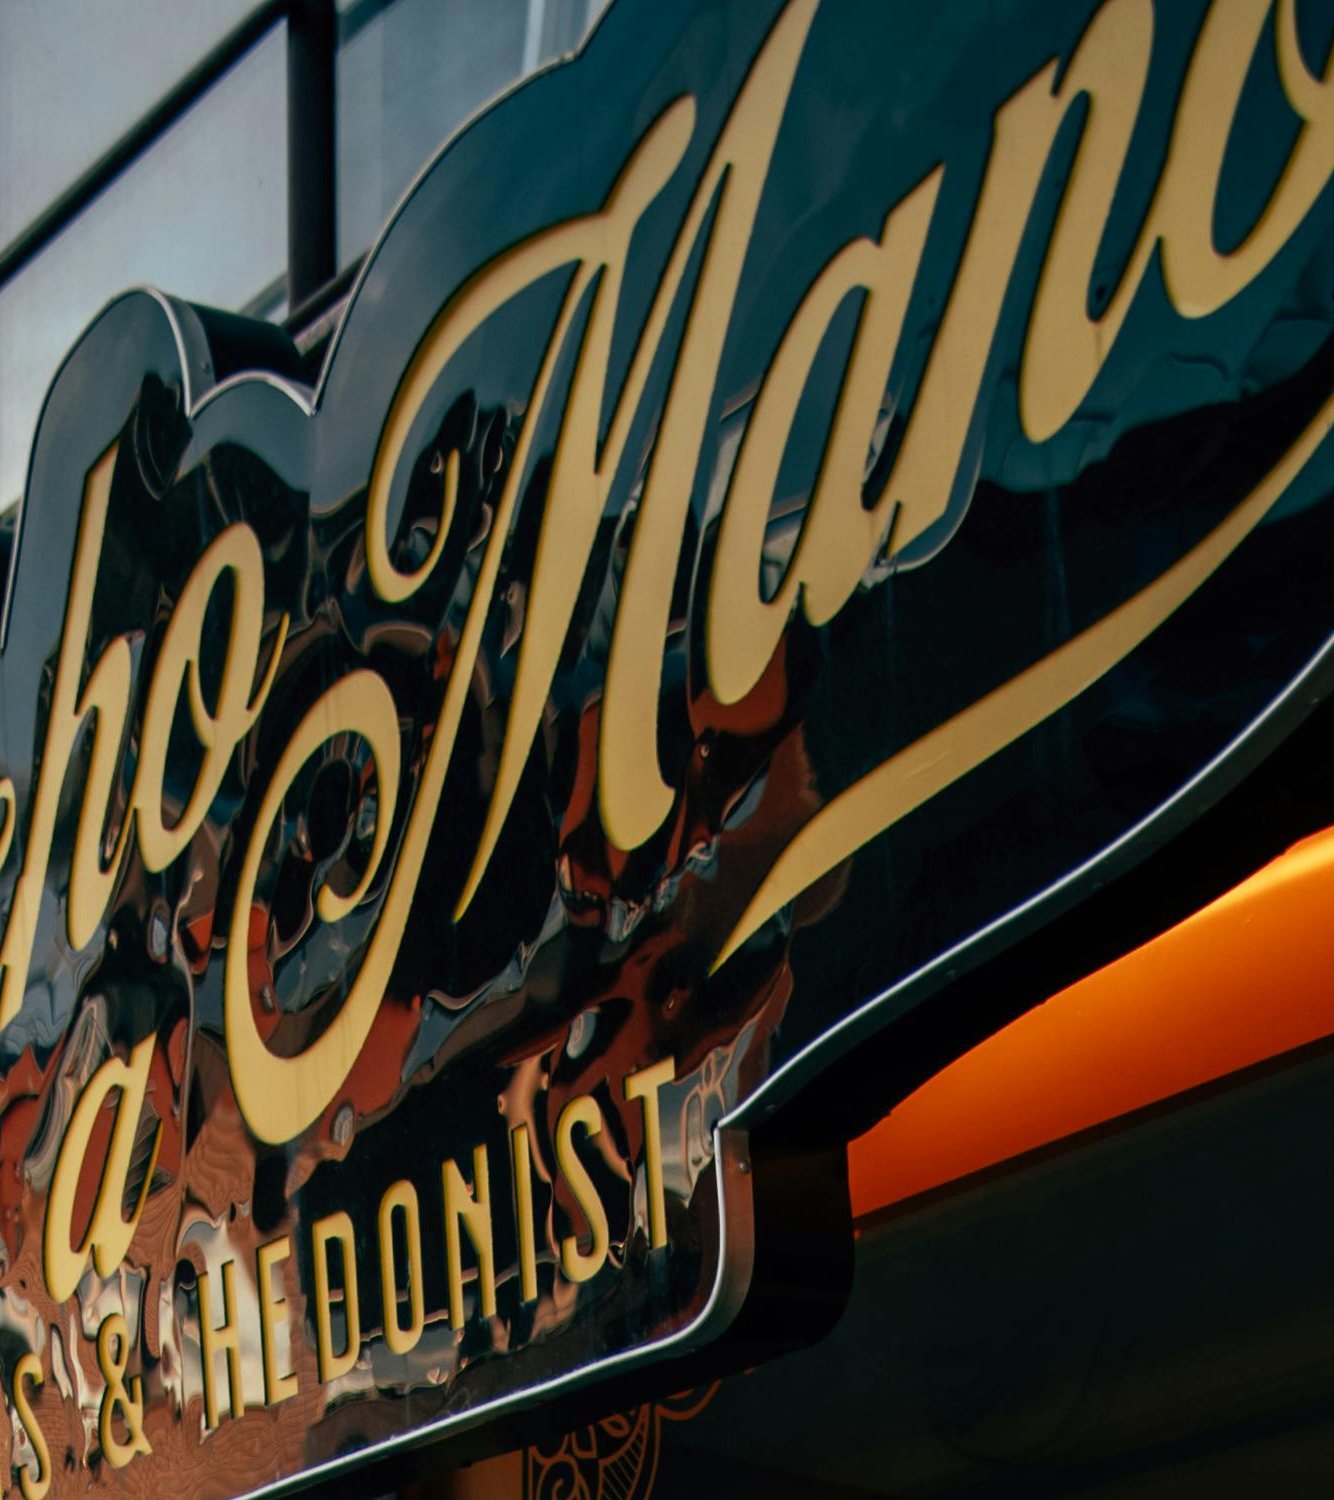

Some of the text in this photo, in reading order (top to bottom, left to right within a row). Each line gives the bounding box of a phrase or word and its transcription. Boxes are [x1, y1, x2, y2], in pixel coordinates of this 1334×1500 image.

[43, 1031, 163, 1304] a
[97, 1312, 154, 1469] &
[195, 1055, 676, 1444] HEDONIST
